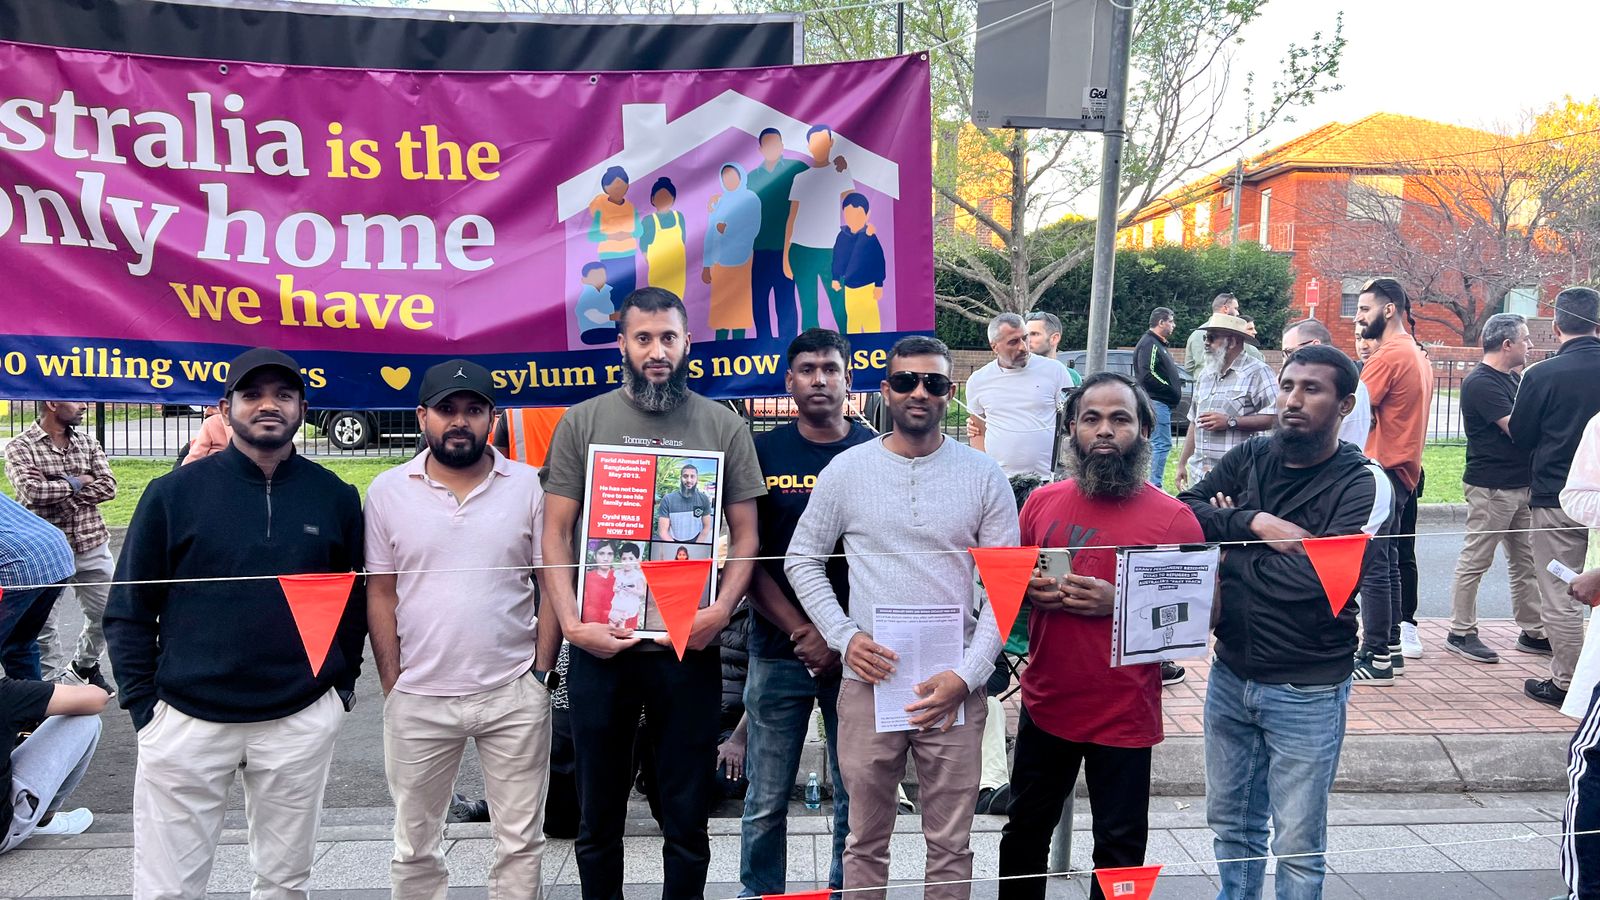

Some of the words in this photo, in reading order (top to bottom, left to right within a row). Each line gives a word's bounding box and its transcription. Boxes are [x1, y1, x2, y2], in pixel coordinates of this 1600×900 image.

[0, 90, 309, 177] stralia
[326, 122, 381, 179] is
[395, 125, 500, 181] the
[197, 183, 496, 271] home
[169, 281, 261, 325] we
[276, 274, 434, 330] have
[0, 351, 27, 376] o
[36, 346, 173, 389] willing
[491, 361, 597, 395] sylum
[712, 354, 780, 376] now
[623, 435, 652, 447] Tommy
[660, 437, 683, 447] Jeans
[603, 464, 640, 472] Bangladesh
[765, 474, 817, 490] POLO
